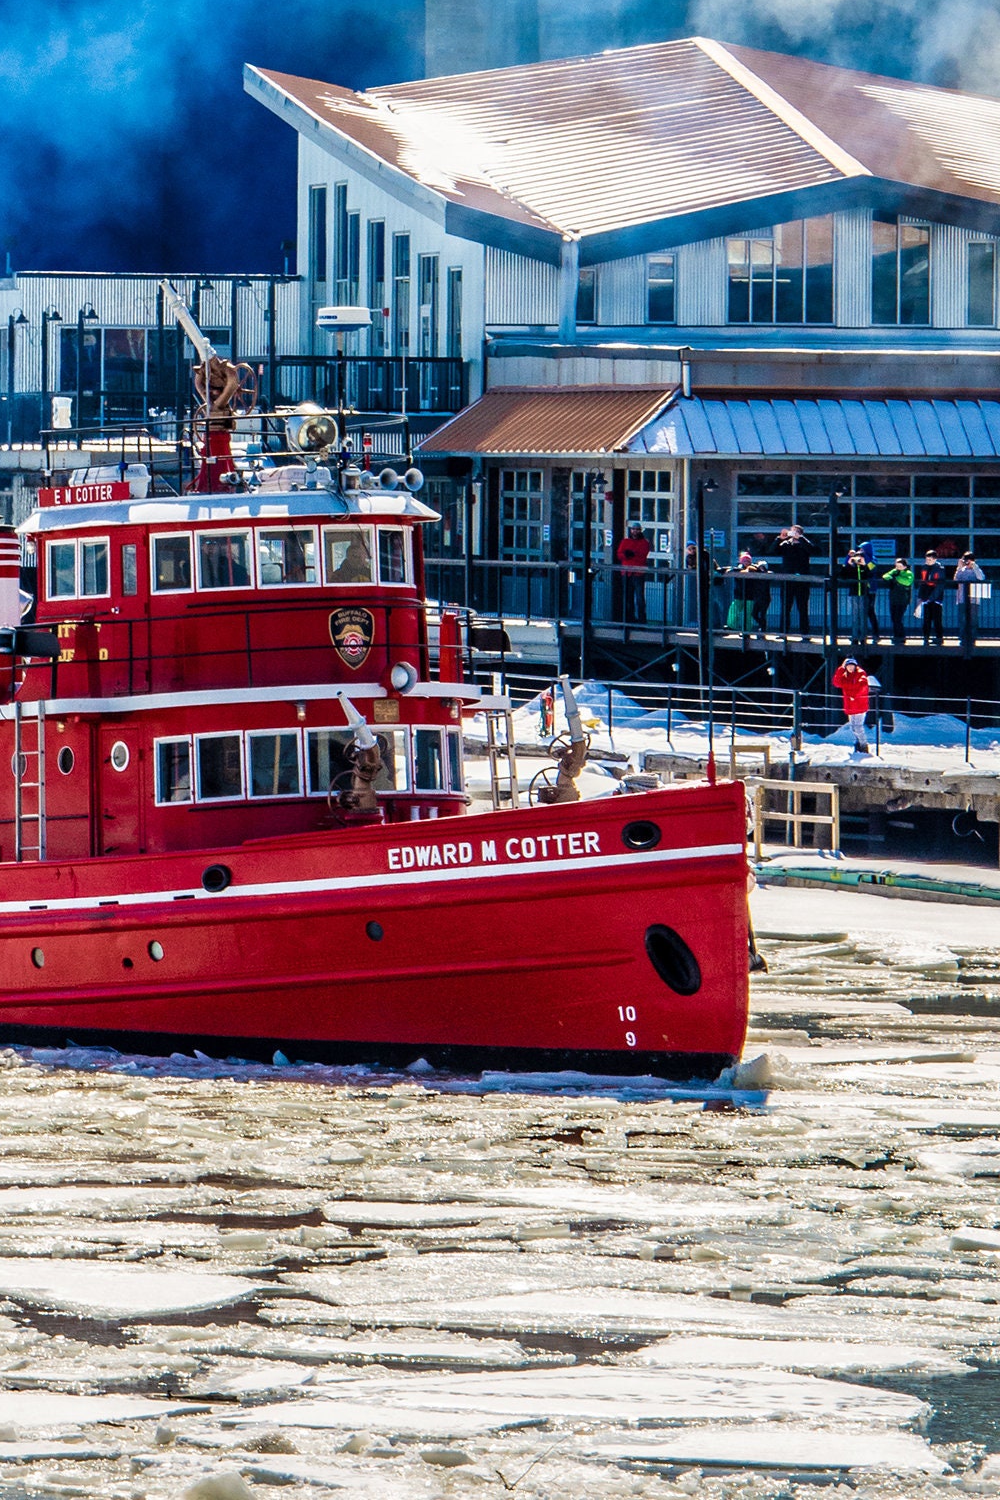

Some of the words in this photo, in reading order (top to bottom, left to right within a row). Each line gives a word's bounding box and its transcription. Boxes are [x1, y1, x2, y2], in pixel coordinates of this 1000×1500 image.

[54, 490, 61, 504] E
[76, 485, 113, 502] COTTER
[387, 842, 472, 870] EDWARD
[481, 840, 497, 862] M
[505, 831, 601, 860] COTTER
[617, 1005, 636, 1022] 10
[625, 1031, 636, 1047] 9
